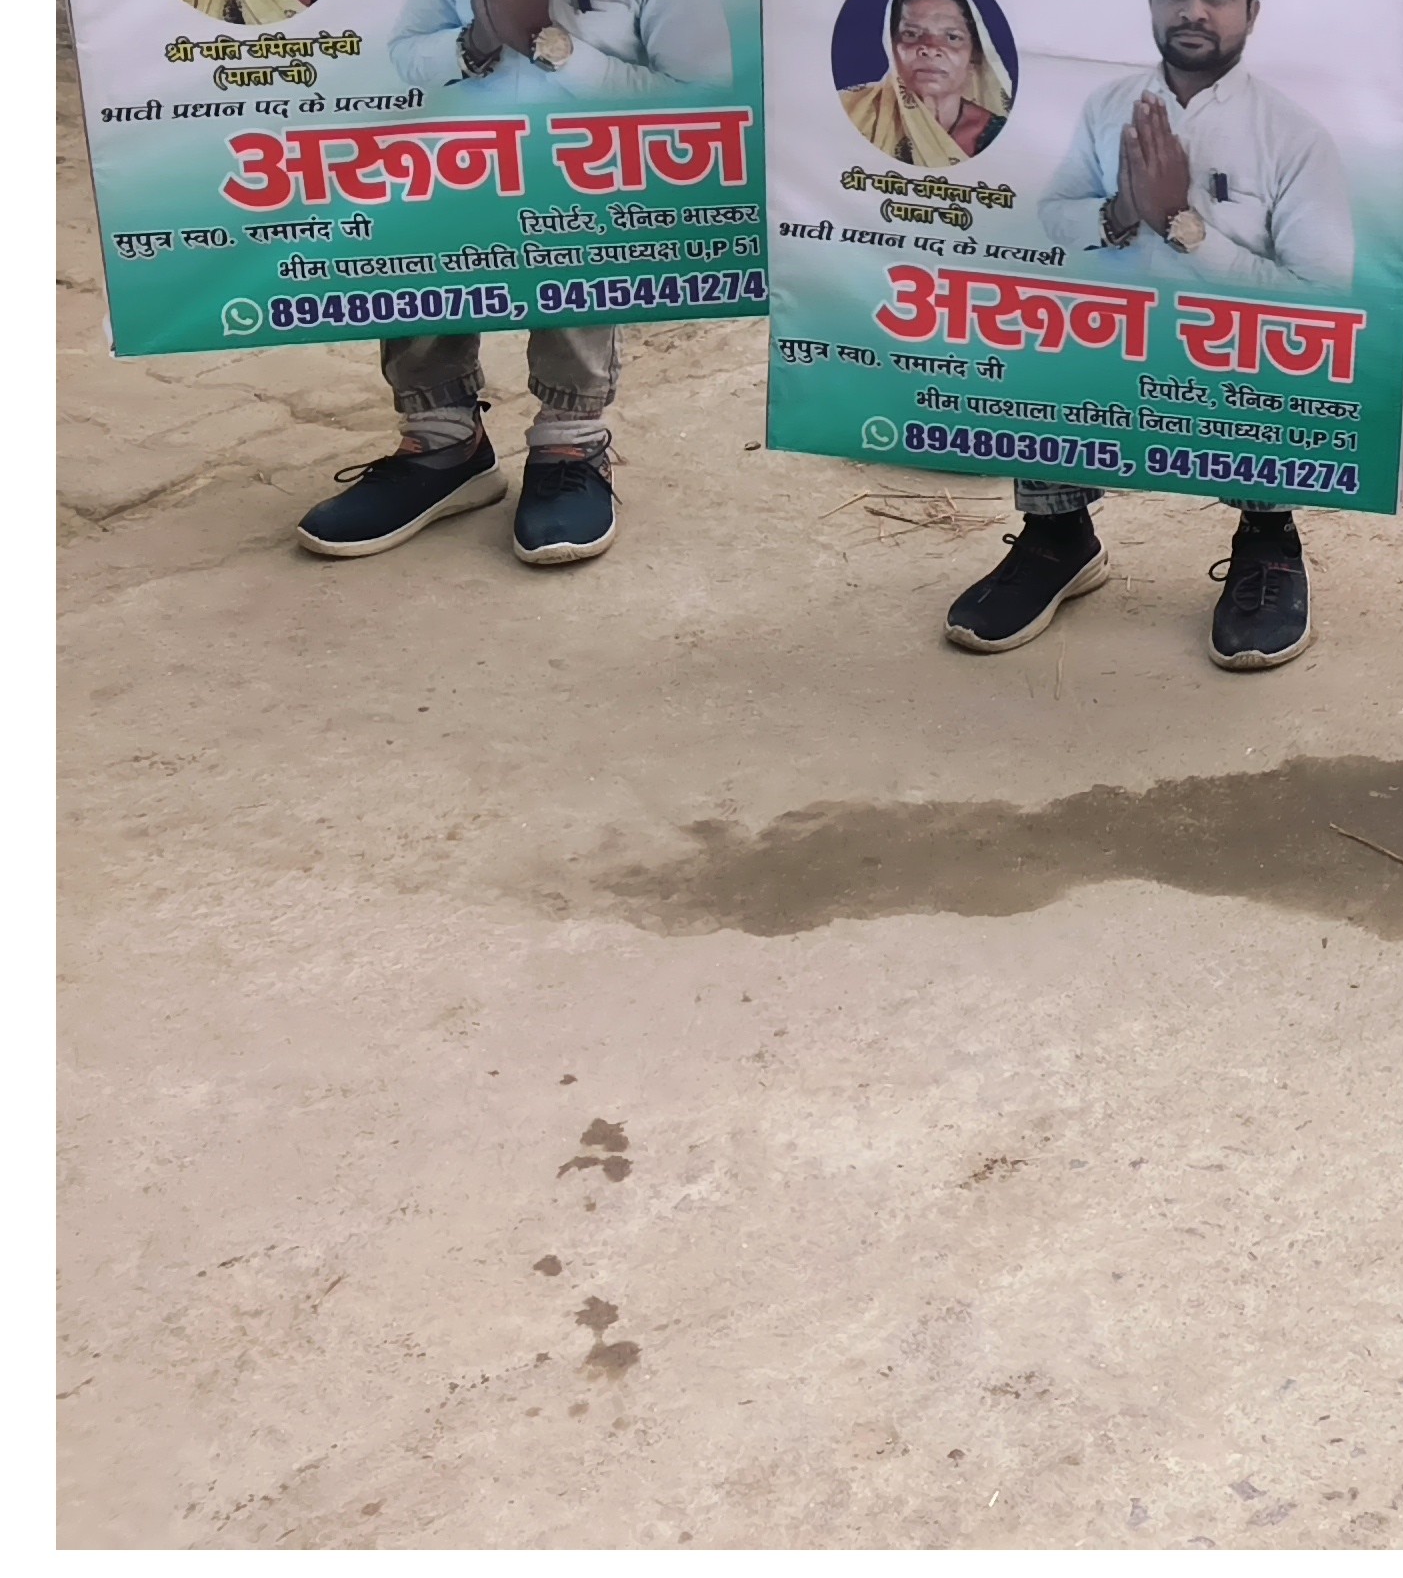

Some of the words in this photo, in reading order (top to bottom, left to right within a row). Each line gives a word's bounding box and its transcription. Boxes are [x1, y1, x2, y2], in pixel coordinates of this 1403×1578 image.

[553, 113, 749, 192] राज
[113, 231, 172, 258] सुपुत्र
[245, 216, 332, 241] रामानंद
[341, 213, 372, 237] जी
[610, 204, 675, 228] दैनिक
[683, 205, 757, 224] भास्कर
[779, 219, 834, 241] भावी
[840, 228, 906, 249] प्रधान
[913, 236, 947, 257] पद
[952, 236, 978, 255] के
[983, 244, 1066, 267] प्रत्याशी
[271, 286, 525, 327] 8948030715,
[539, 271, 765, 311] 9415441274
[1180, 298, 1364, 380] राज
[1223, 383, 1282, 410] दैनिक
[1289, 397, 1359, 419] भास्कर
[906, 423, 1133, 474] 8948030715,
[1148, 447, 1357, 492] 9415441274
